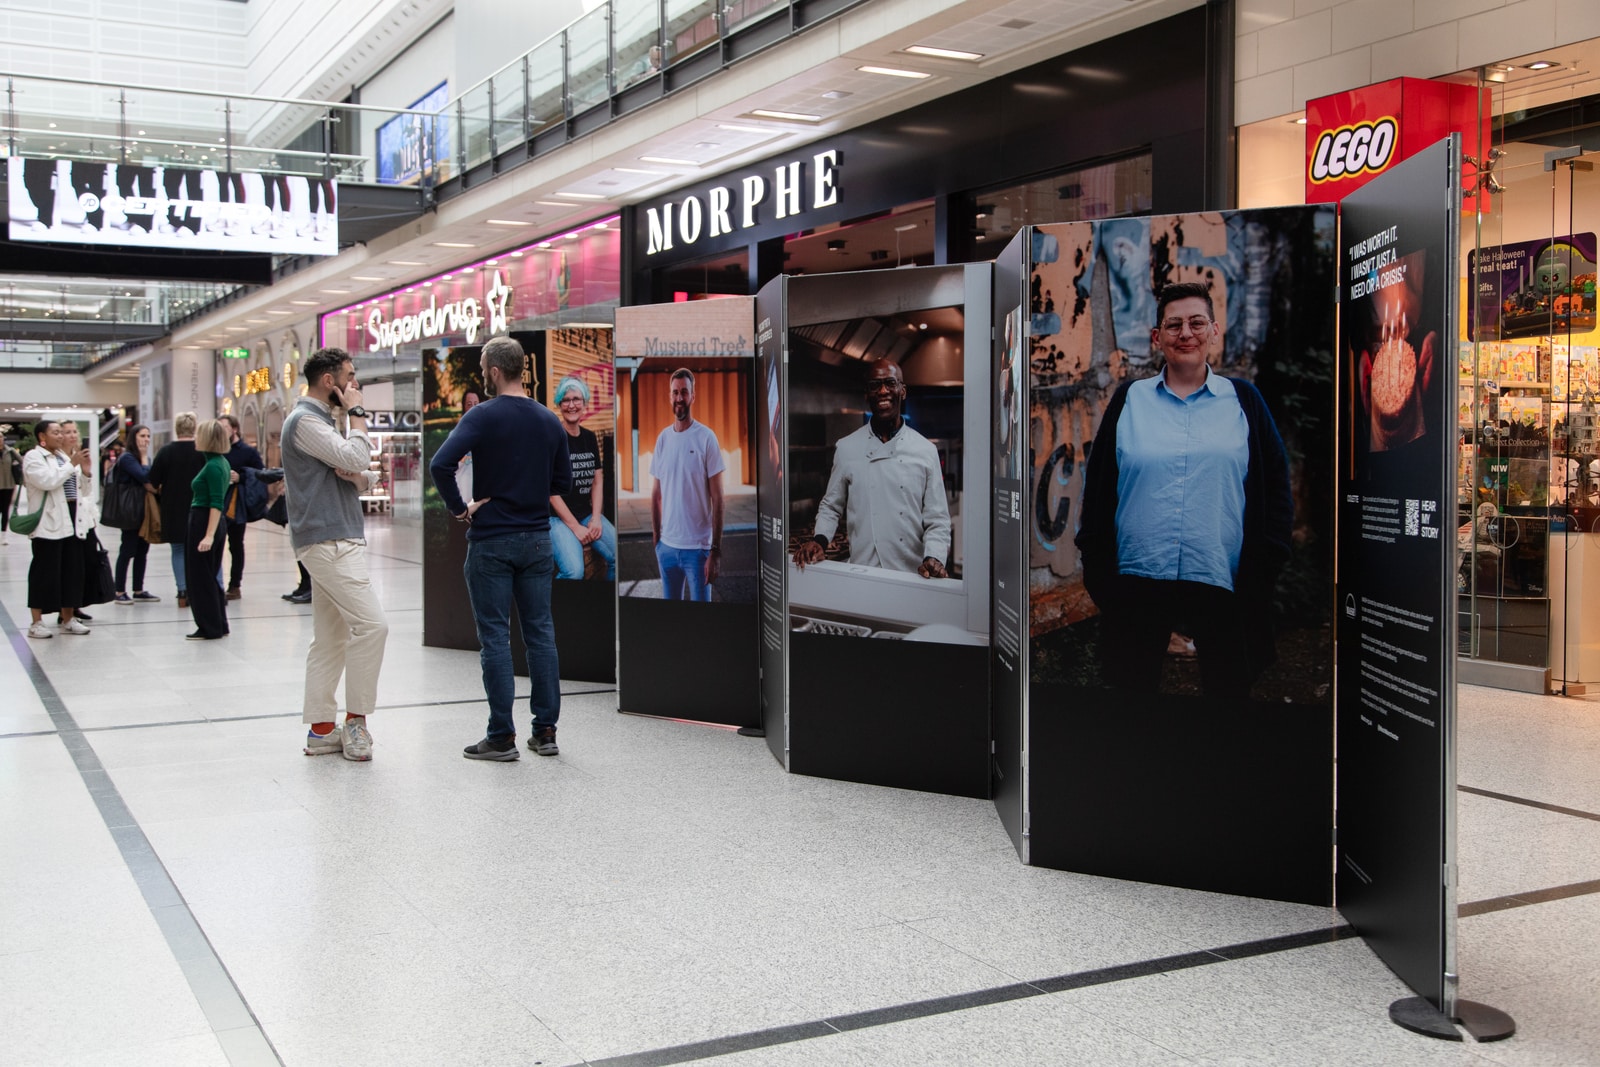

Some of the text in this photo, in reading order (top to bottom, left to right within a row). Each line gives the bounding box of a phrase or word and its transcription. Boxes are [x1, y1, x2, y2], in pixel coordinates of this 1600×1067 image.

[1312, 119, 1396, 182] LEGO
[646, 149, 838, 255] MORPHE
[1354, 241, 1367, 259] WAS
[1367, 229, 1390, 253] WORTH
[1389, 225, 1398, 243] IT.
[1354, 256, 1376, 279] WASN'T
[1375, 248, 1391, 270] JUST
[1391, 247, 1397, 263] A
[1480, 264, 1494, 273] real
[1497, 260, 1516, 270] teat!
[1492, 250, 1525, 262] Haloween
[1350, 281, 1366, 301] NEED
[1366, 277, 1375, 295] OR
[1375, 275, 1380, 291] A
[368, 294, 482, 357] Superdrug
[644, 334, 706, 354] Mustard
[711, 337, 745, 354] Tree
[191, 362, 199, 409] FRENCH
[1489, 438, 1540, 447] Insct Collection
[1421, 500, 1437, 512] HEAR
[1421, 513, 1431, 525] MY
[1421, 526, 1439, 539] STORY
